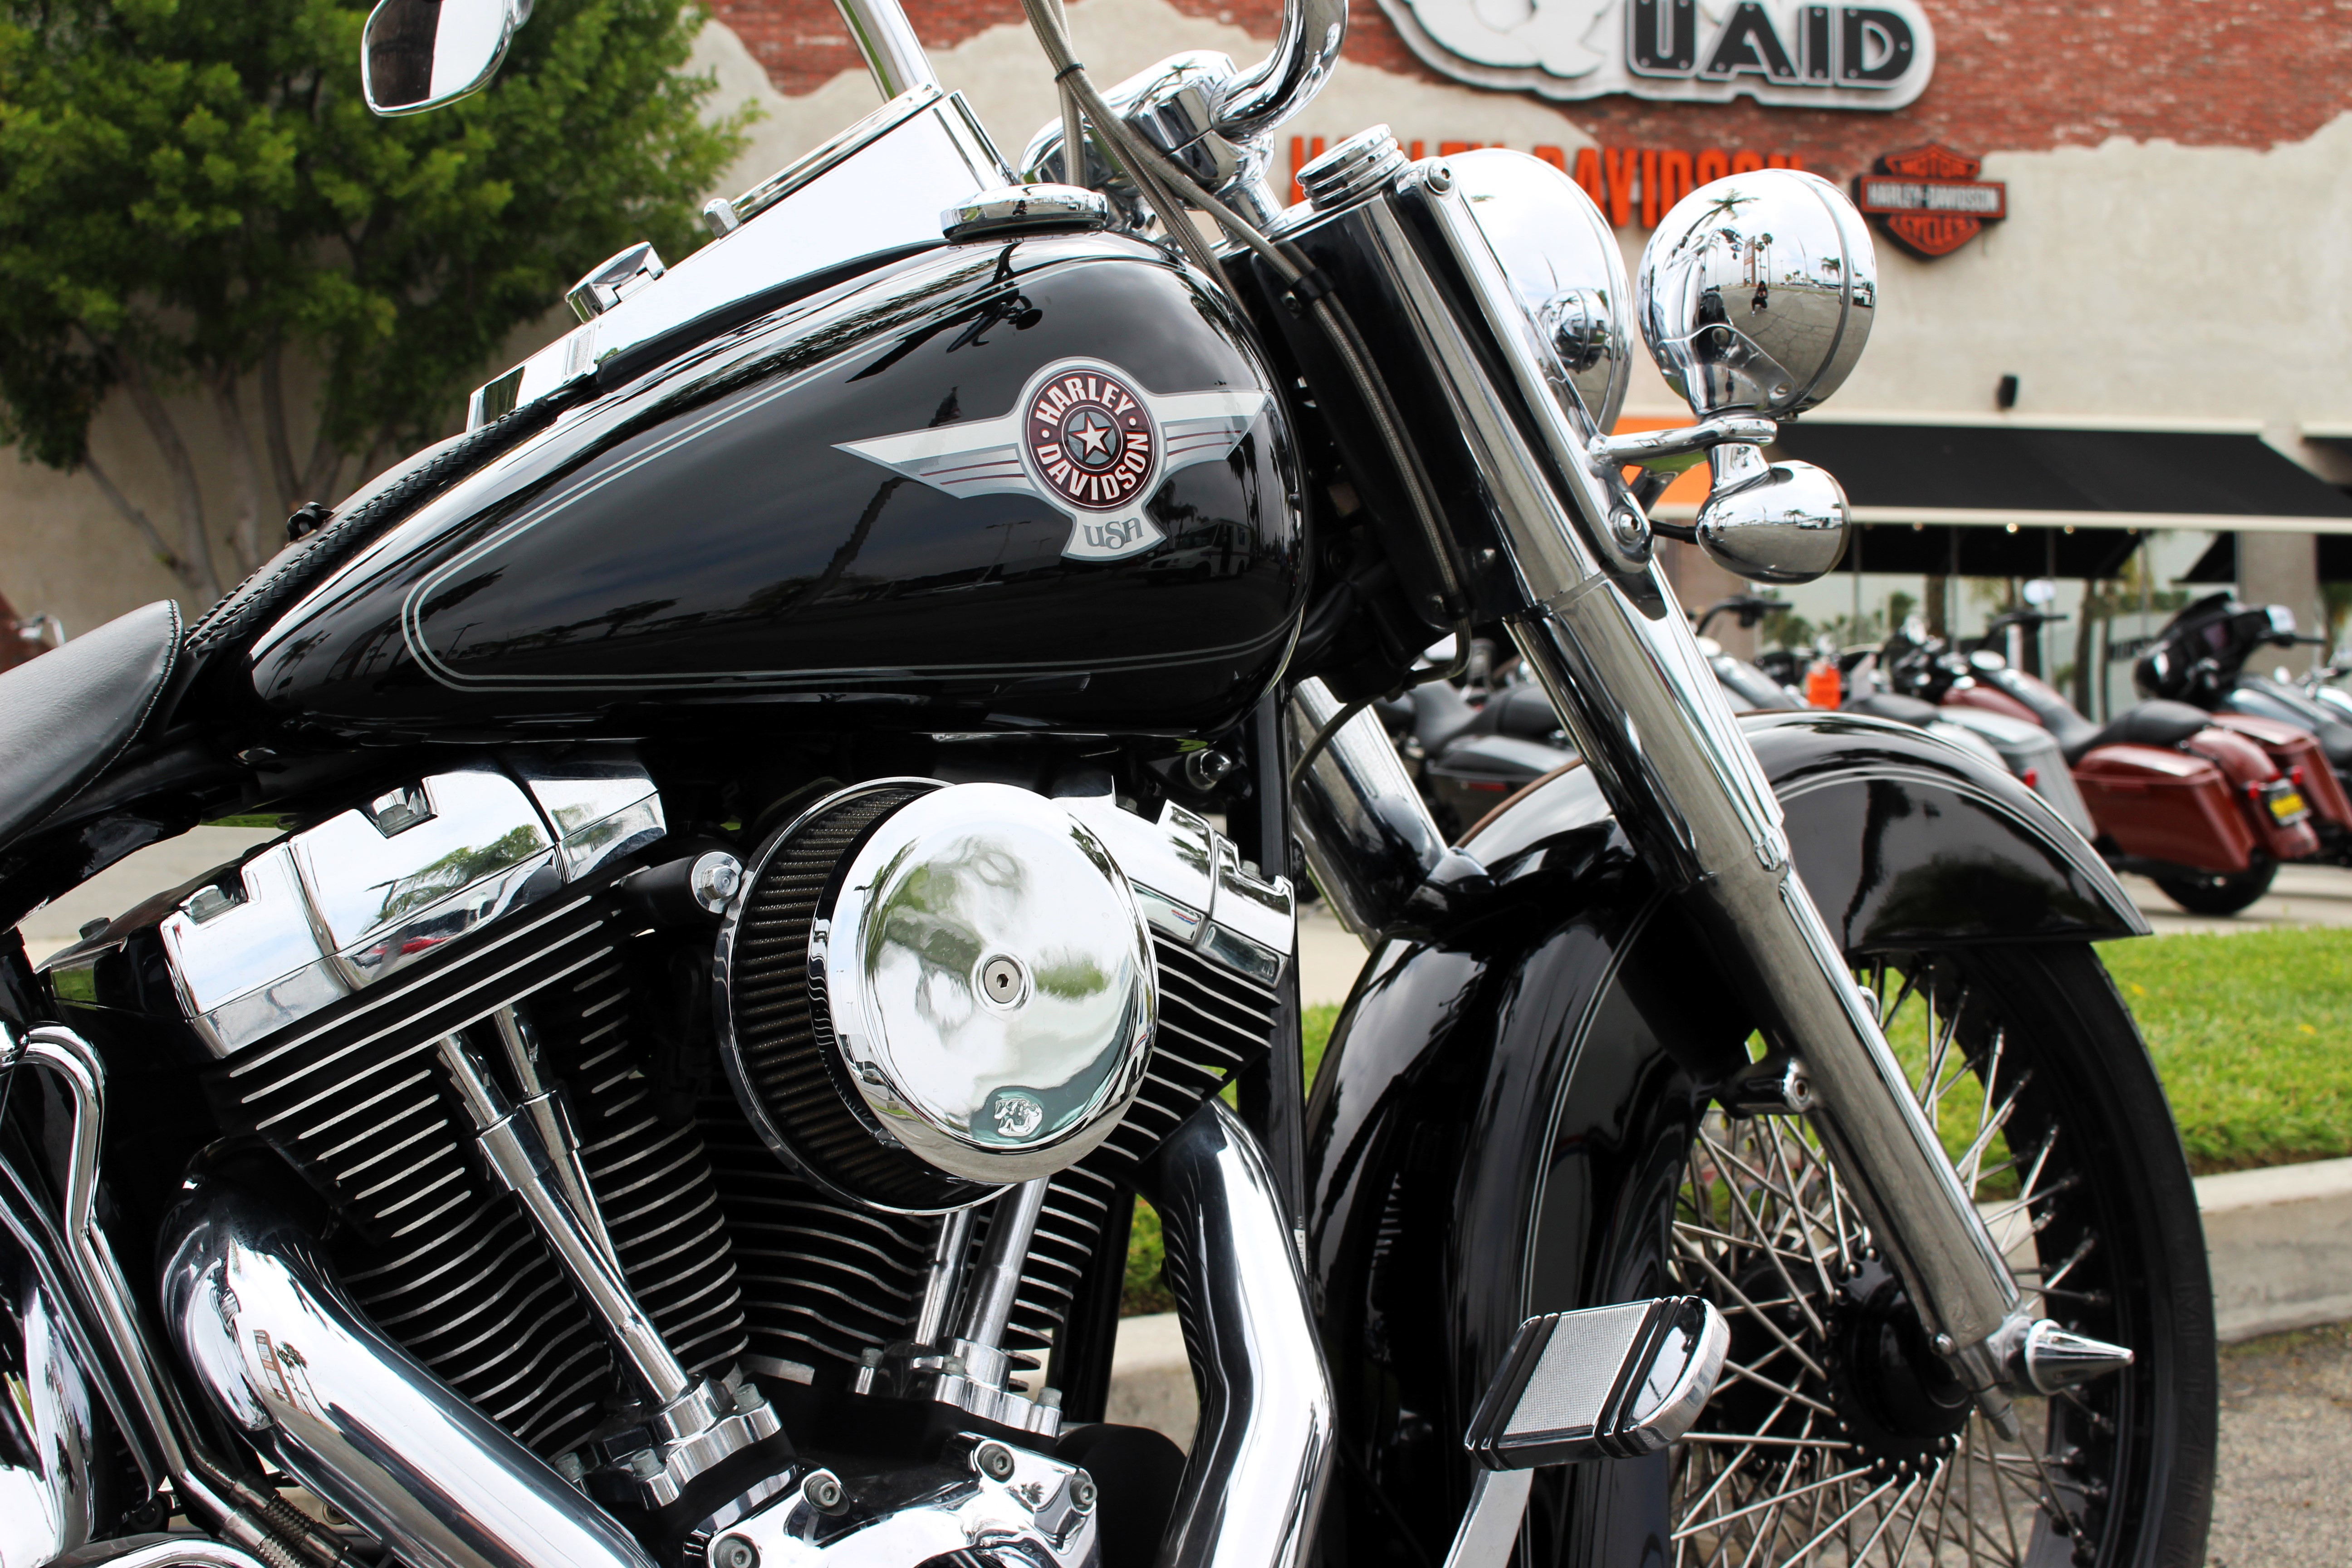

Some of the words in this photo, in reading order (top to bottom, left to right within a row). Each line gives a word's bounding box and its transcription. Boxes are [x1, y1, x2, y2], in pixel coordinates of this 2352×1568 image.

[1035, 376, 1136, 426] HARLEY
[1036, 430, 1149, 500] DAVIDSON
[1083, 517, 1144, 549] USA
